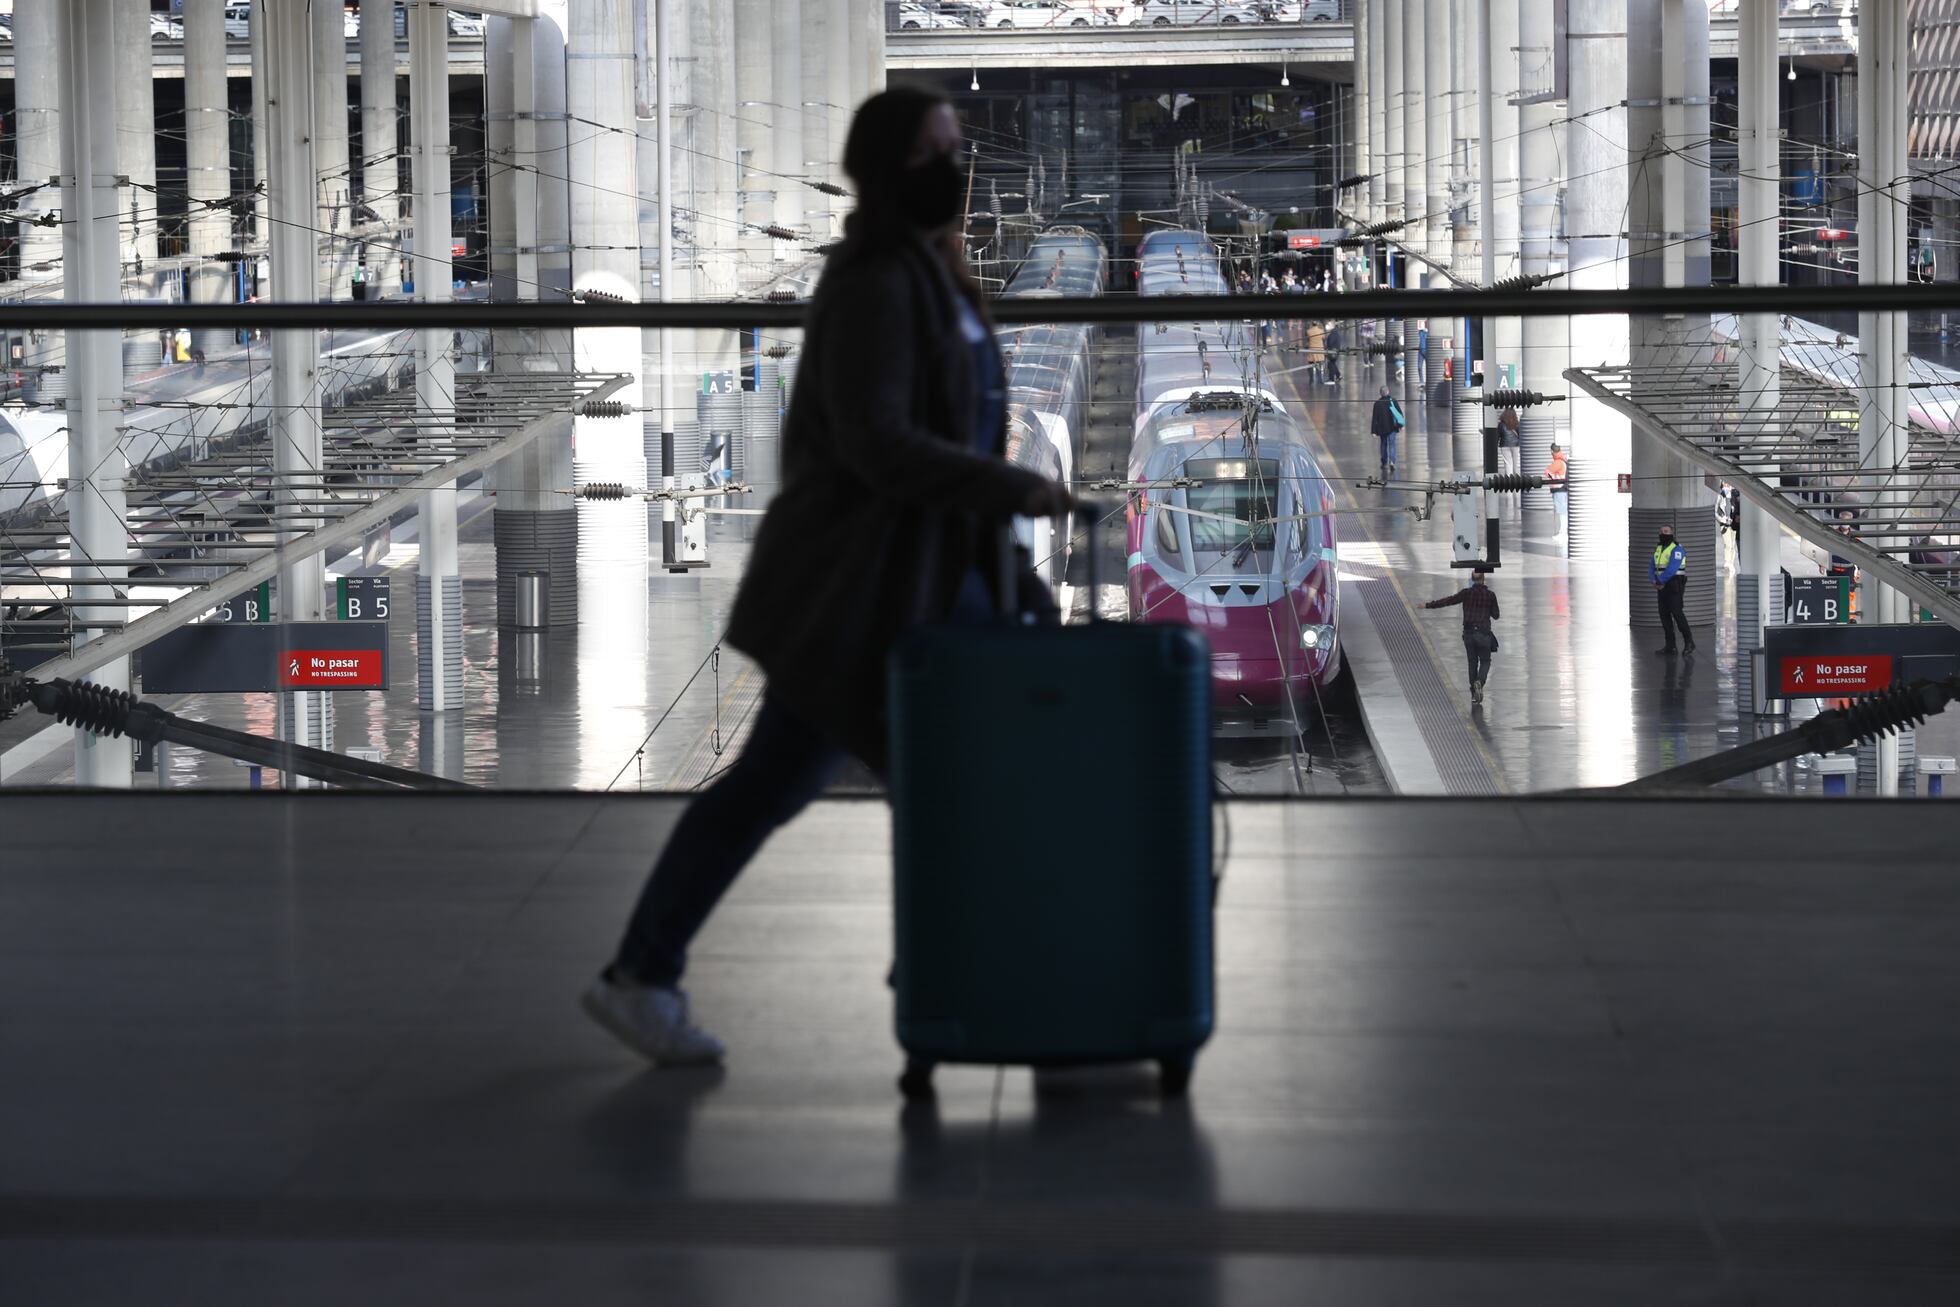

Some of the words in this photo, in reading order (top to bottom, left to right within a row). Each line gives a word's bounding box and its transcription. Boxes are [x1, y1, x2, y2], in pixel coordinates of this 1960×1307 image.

[709, 380, 719, 393] A
[724, 380, 733, 393] 5
[1500, 375, 1509, 388] A
[245, 600, 258, 621] B
[348, 597, 361, 618] B
[376, 597, 388, 618] 5
[1796, 599, 1811, 621] 4
[1824, 599, 1838, 620] B
[311, 657, 326, 668] No
[329, 658, 359, 670] pasar
[1816, 664, 1832, 675] No
[1835, 664, 1868, 677] pasar
